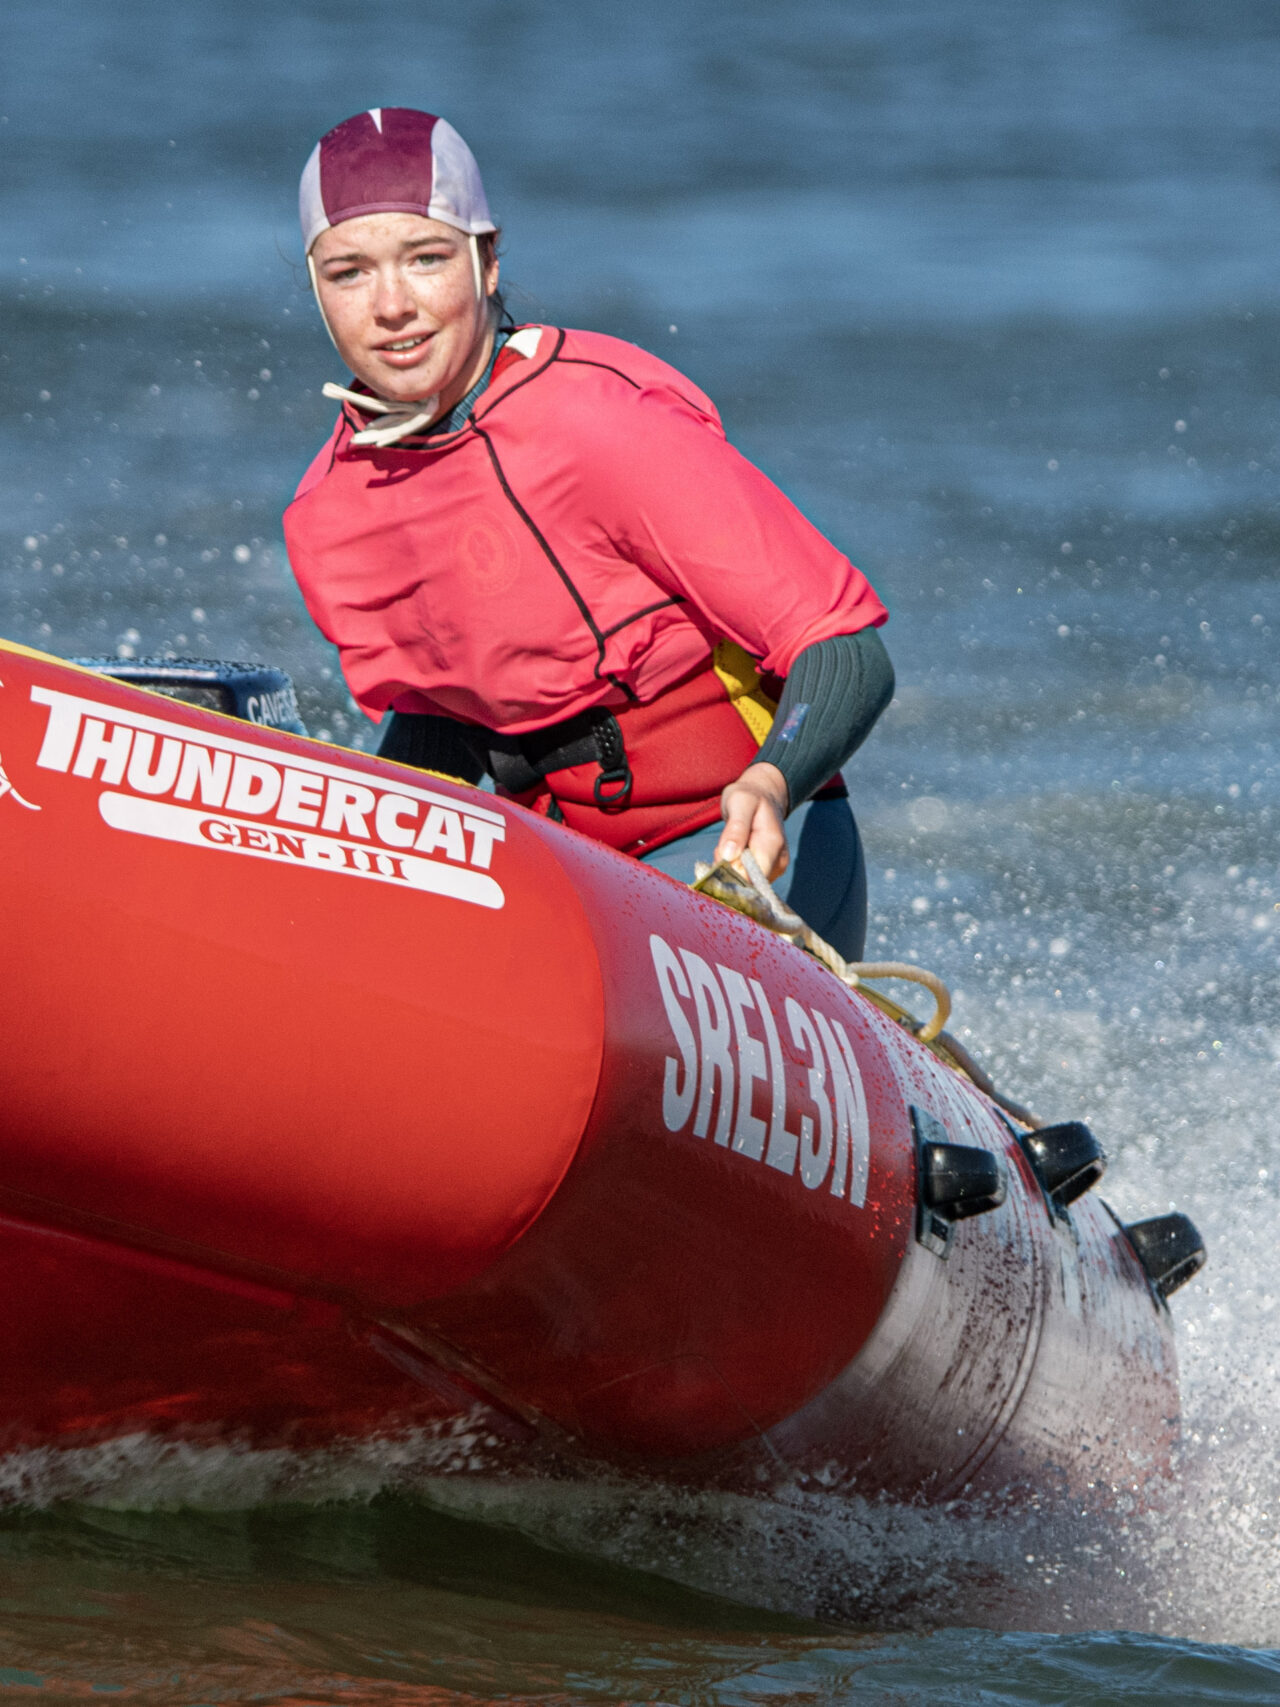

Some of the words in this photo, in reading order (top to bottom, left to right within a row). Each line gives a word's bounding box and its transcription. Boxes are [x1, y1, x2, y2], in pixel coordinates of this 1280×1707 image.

[30, 685, 506, 869] THUNDERCAT
[199, 819, 410, 881] GEN-III
[649, 933, 869, 1209] SREL3N
